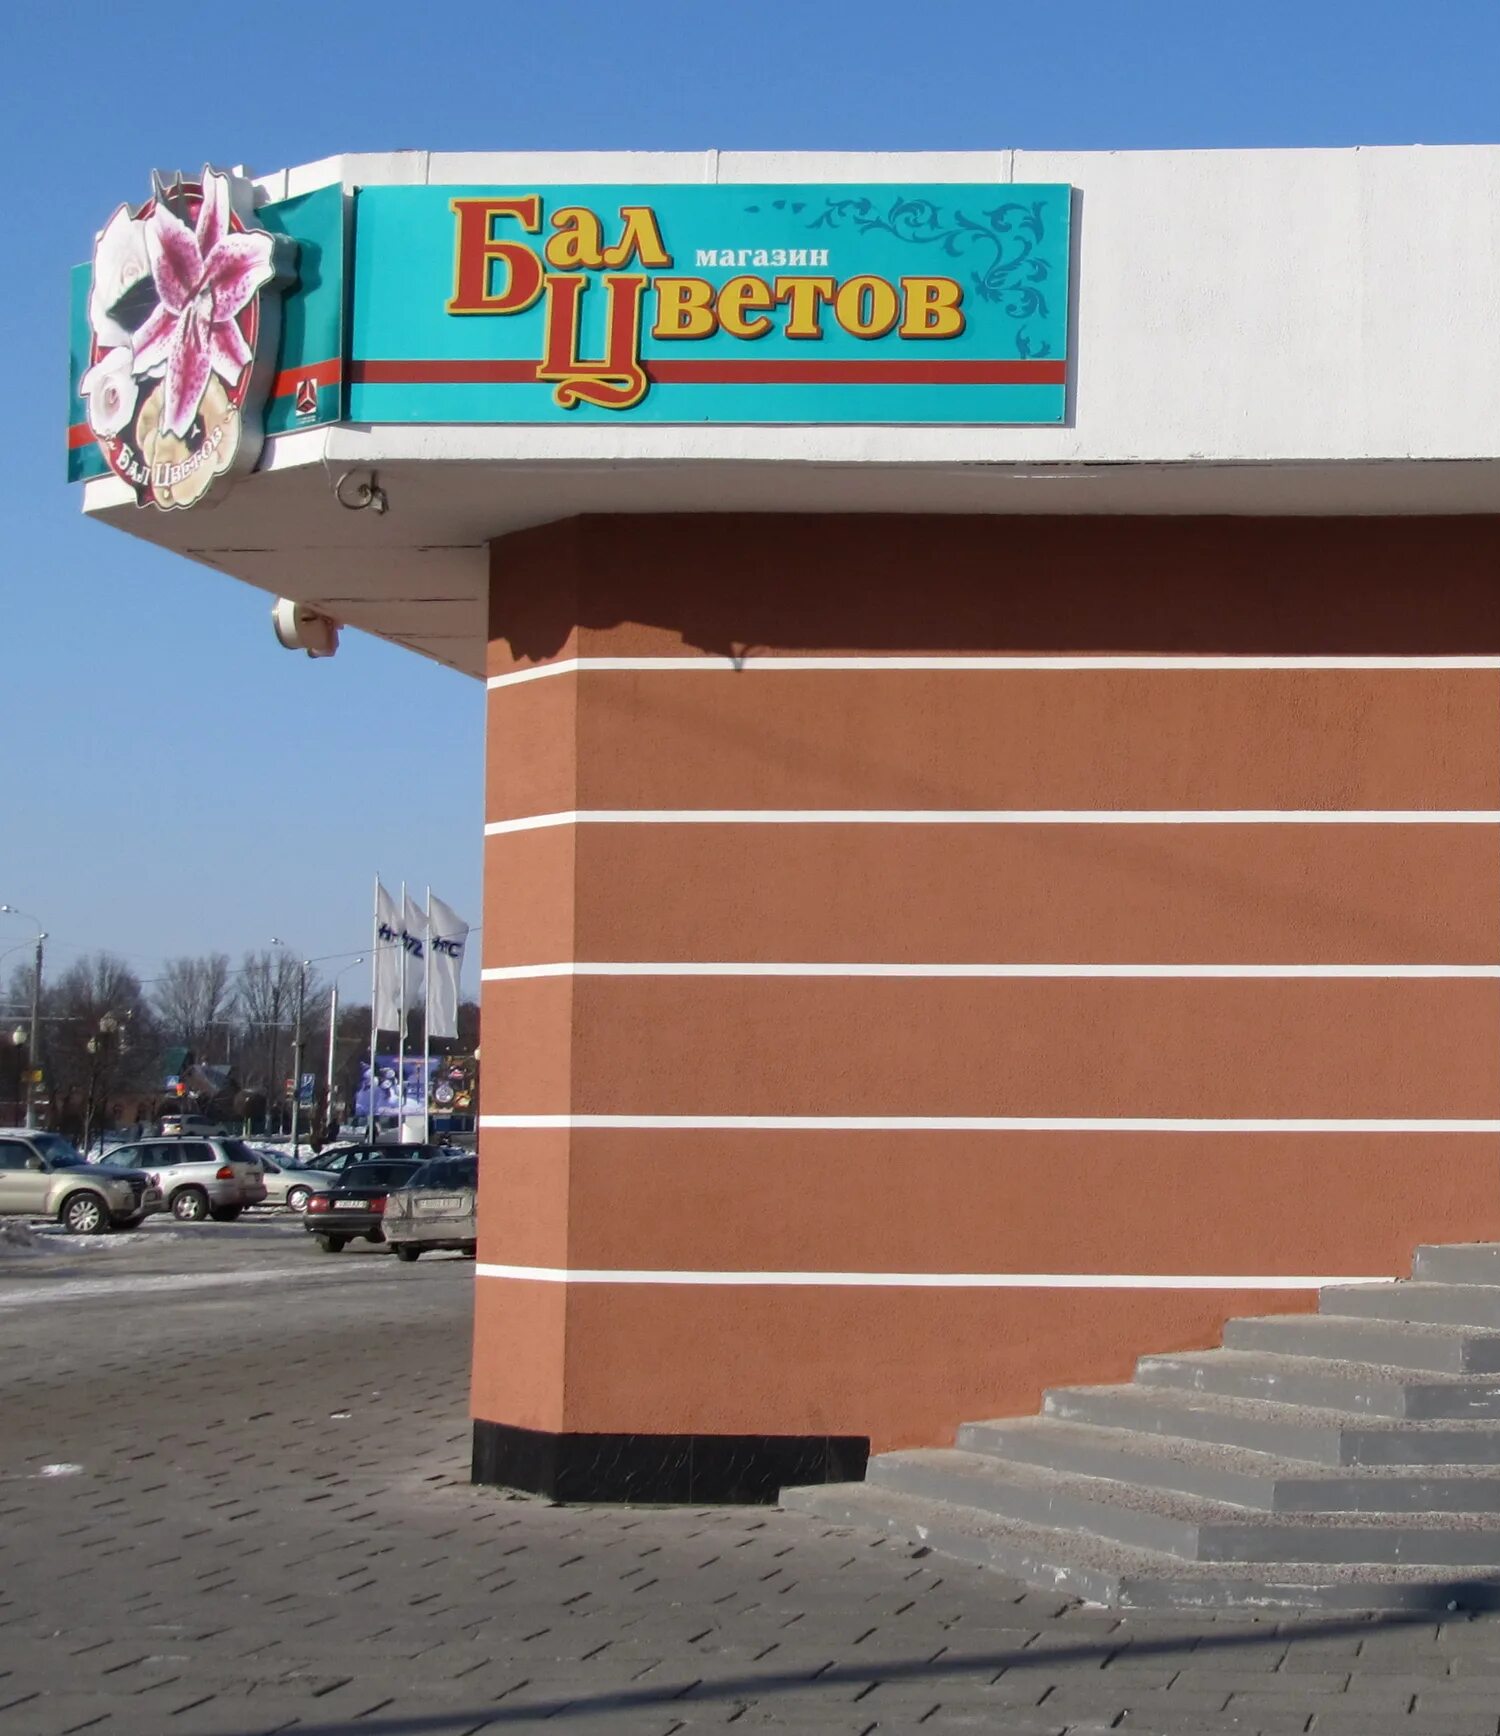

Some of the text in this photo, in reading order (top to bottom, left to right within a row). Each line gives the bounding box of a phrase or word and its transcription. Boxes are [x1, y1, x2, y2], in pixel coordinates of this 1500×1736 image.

[446, 194, 672, 314] Бал
[695, 248, 830, 268] магазин
[536, 274, 966, 409] Цветов
